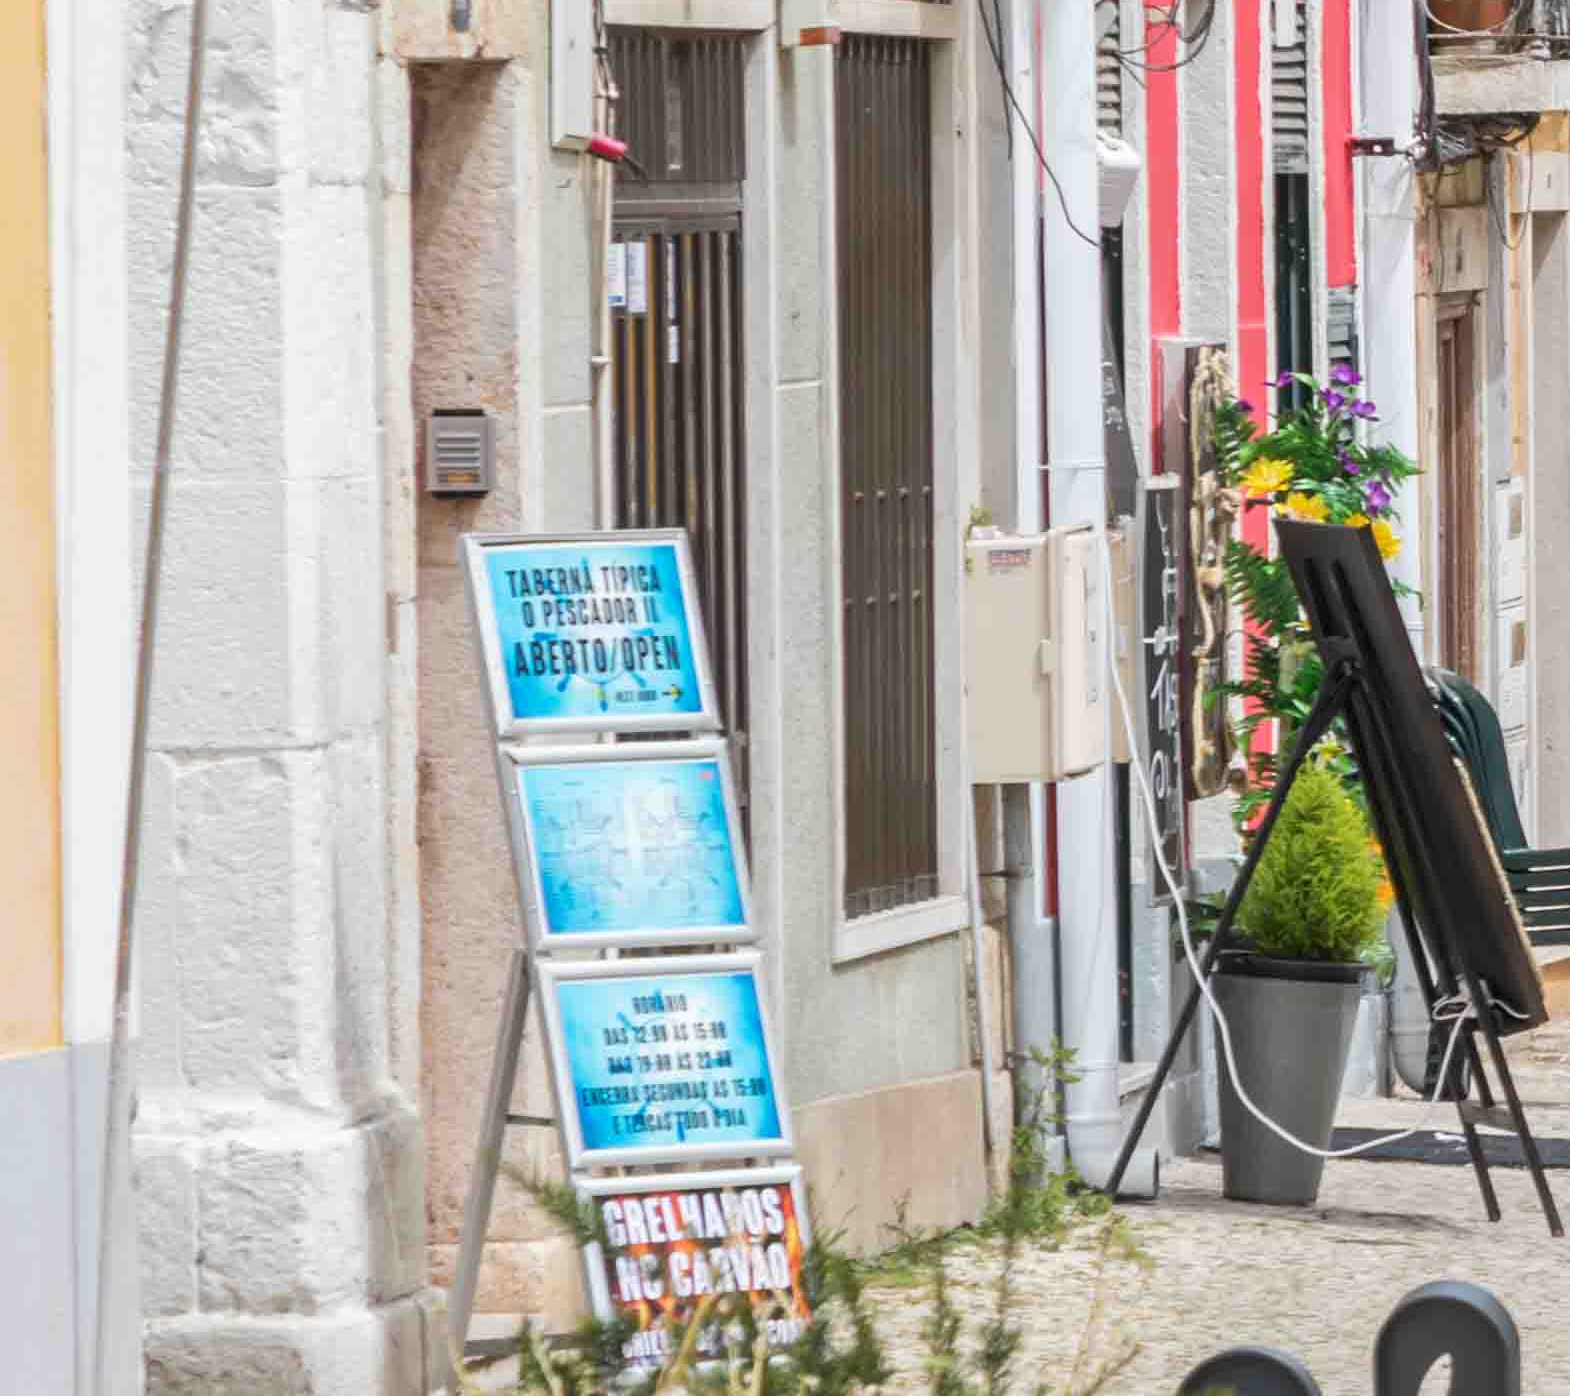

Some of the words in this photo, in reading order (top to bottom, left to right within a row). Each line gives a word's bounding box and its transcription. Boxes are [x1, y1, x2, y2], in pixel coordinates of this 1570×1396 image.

[505, 566, 594, 598] TABERNA
[521, 600, 536, 629] O
[541, 597, 639, 627] PESCADOR
